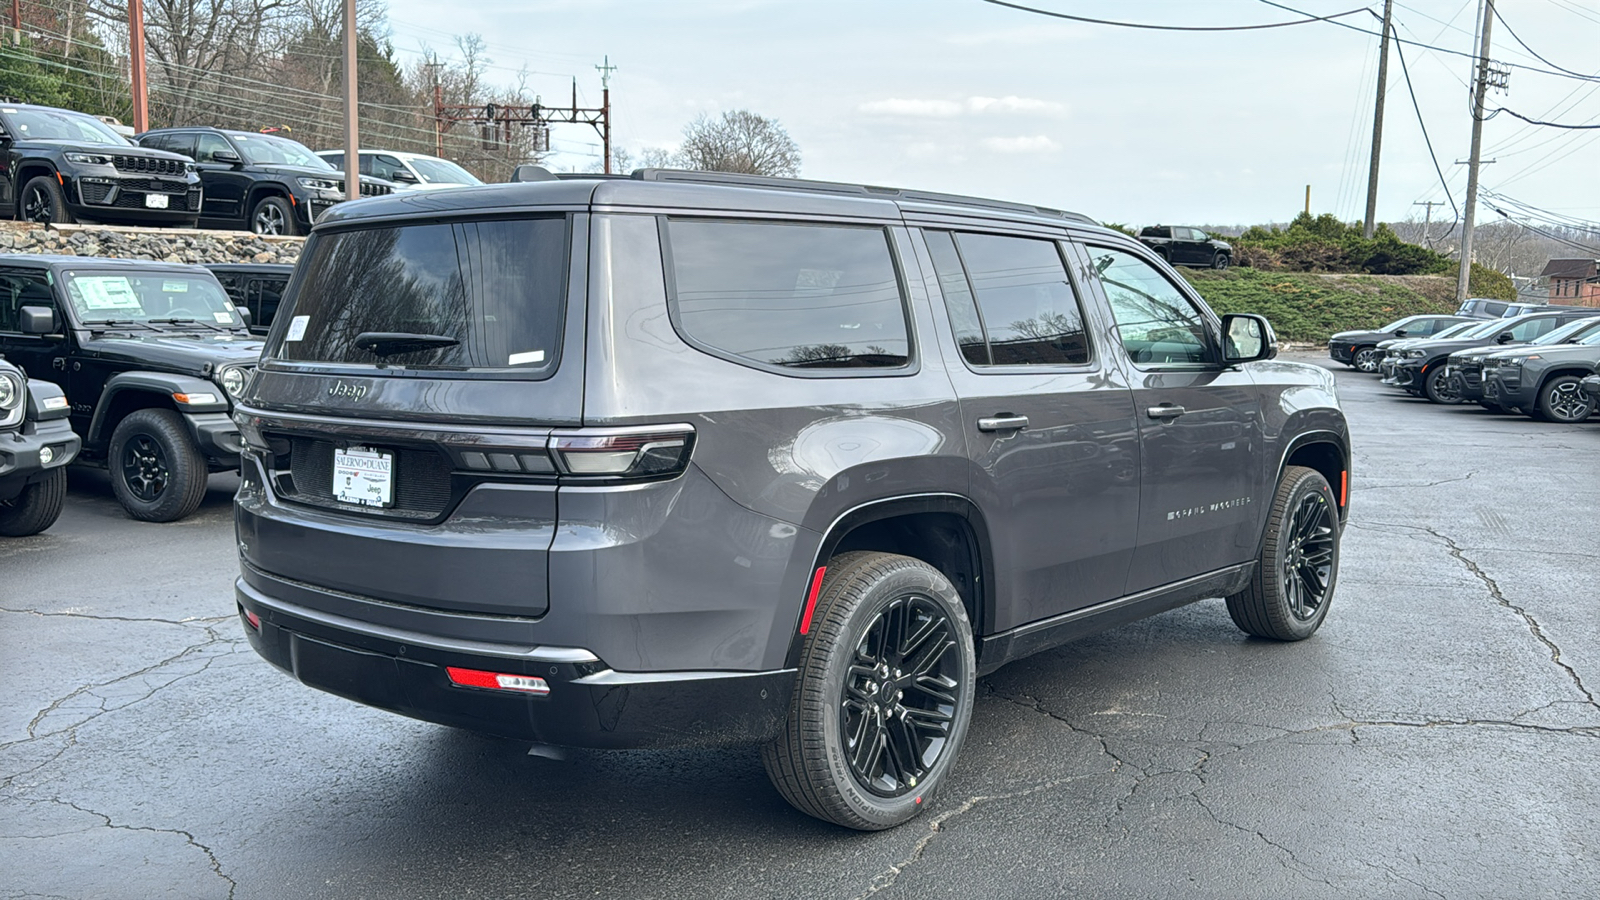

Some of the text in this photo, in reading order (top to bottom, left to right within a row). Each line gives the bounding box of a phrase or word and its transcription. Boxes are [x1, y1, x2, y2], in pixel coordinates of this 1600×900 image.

[329, 380, 367, 402] Jeep
[336, 456, 390, 471] SALERNO DUANE
[367, 484, 381, 495] Jeep
